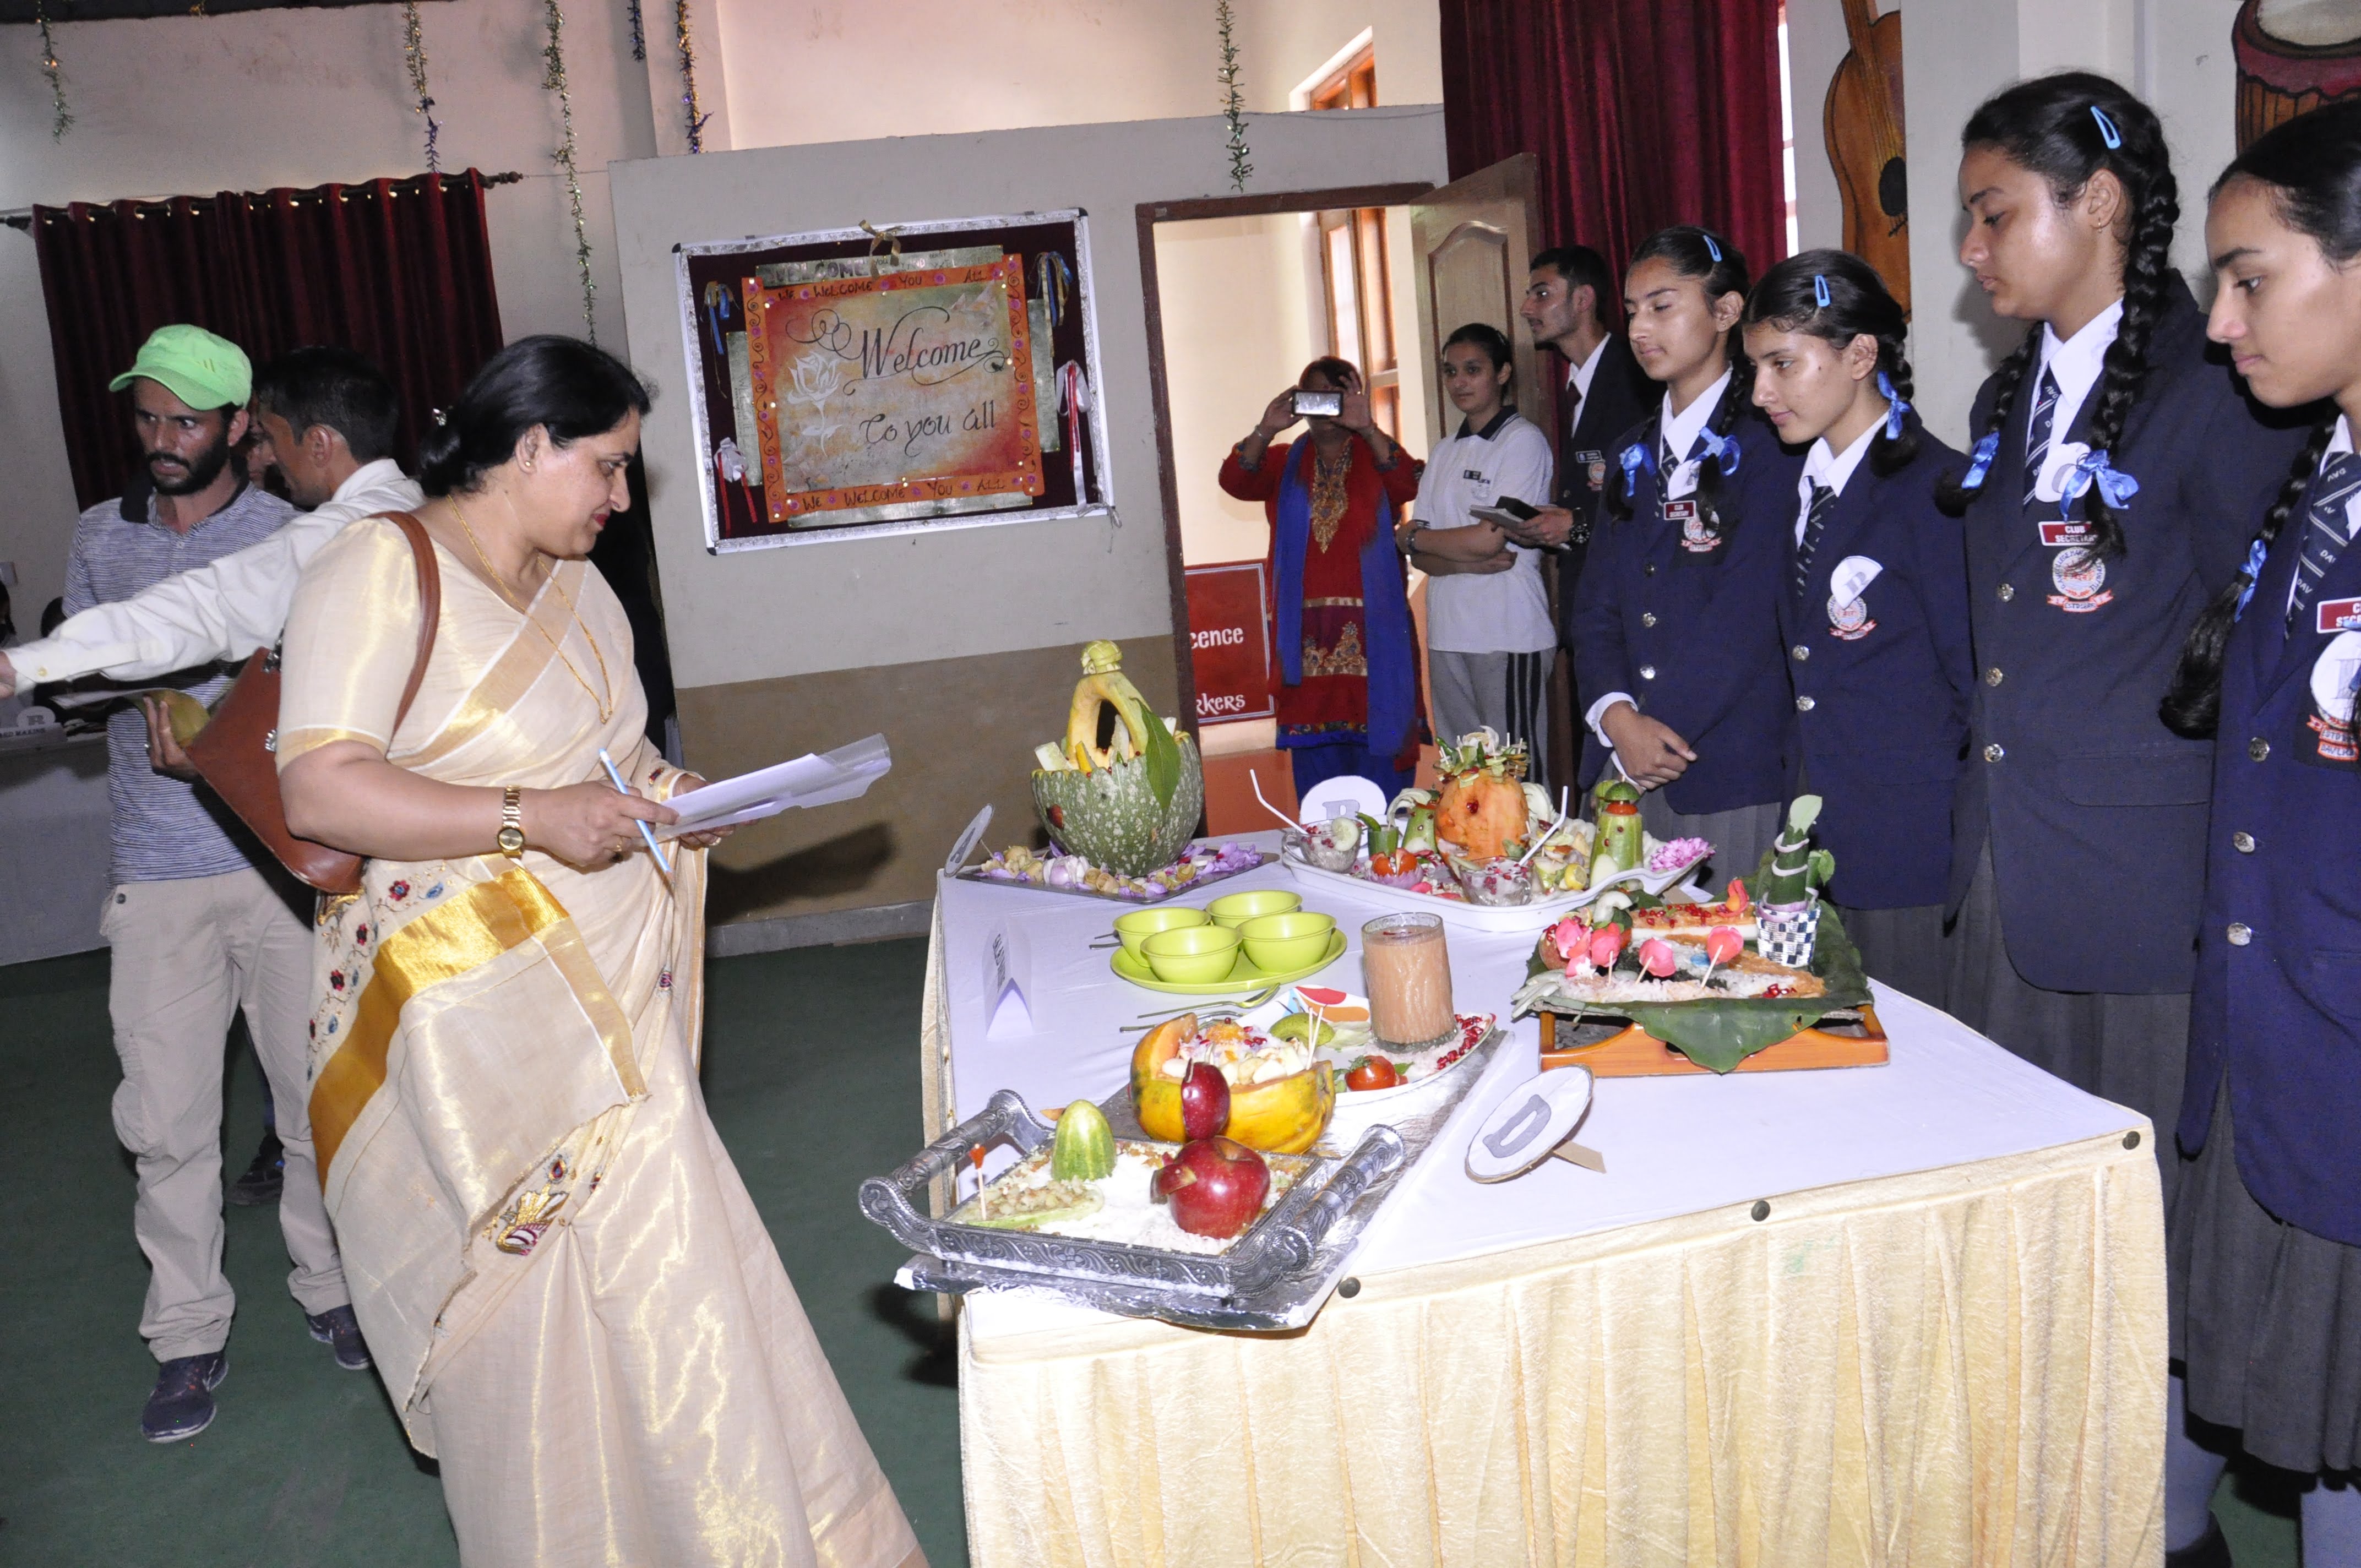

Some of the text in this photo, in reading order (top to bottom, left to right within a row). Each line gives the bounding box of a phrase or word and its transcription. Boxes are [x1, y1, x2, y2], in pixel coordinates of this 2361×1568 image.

[813, 281, 873, 298] WELCOME
[899, 276, 922, 289] YOU
[848, 306, 999, 385] Welcome
[904, 415, 952, 458] you
[963, 400, 995, 431] all
[2327, 467, 2347, 482] DAV
[803, 498, 822, 511] WE
[844, 488, 906, 508] WELCOME
[927, 481, 954, 498] YOU
[977, 478, 1005, 491] ALL
[2297, 578, 2313, 594] DAV
[950, 826, 976, 864] A
[1482, 1094, 1552, 1158] D
